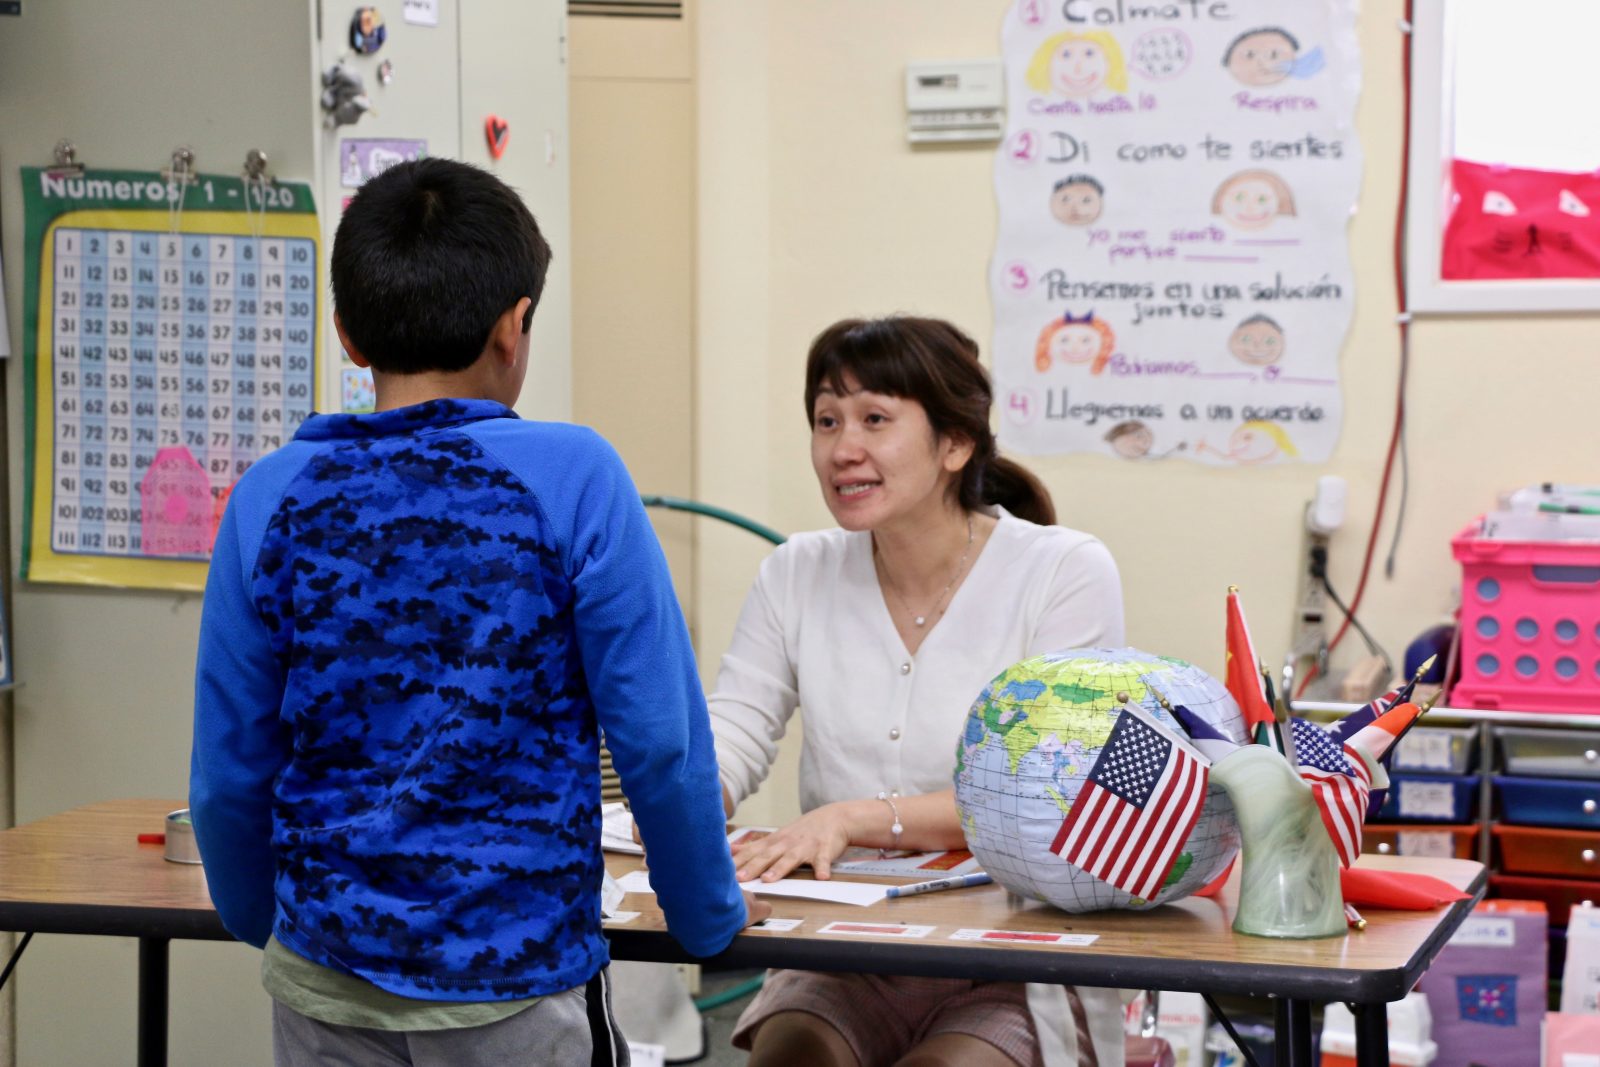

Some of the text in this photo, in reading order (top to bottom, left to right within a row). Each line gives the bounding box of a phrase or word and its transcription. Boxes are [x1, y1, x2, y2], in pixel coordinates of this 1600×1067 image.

[1026, 0, 1040, 24] 1
[1013, 131, 1344, 163] 2 Di como te sientes
[40, 173, 181, 201] Numeros
[204, 181, 215, 202] 1
[252, 187, 294, 207] 120
[66, 237, 308, 263] 1 2 3 4 5 6 7 8 9 10
[63, 265, 310, 291] 11 12 13 14 15 16 17 18 19 20
[1008, 265, 1030, 289] 3
[1040, 268, 1154, 301] Pensemos
[1164, 280, 1192, 299] en
[1202, 280, 1241, 300] una
[61, 291, 76, 307] 21
[85, 292, 104, 308] 22
[110, 293, 130, 309] 23
[136, 294, 156, 310] 24
[187, 297, 207, 313] 26
[213, 298, 232, 314] 27
[238, 299, 257, 315] 28
[263, 300, 283, 316] 29
[289, 301, 310, 318] 30
[1132, 301, 1224, 325] juntos
[60, 317, 76, 333] 31
[84, 318, 103, 335] 32
[110, 320, 129, 336] 33
[135, 321, 155, 337] 34
[186, 324, 206, 340] 36
[212, 325, 231, 340] 37
[237, 326, 257, 342] 38
[262, 327, 282, 343] 39
[287, 329, 309, 344] 40
[59, 346, 308, 371] 41 42 43 44 45 46 47 48 49 50
[60, 372, 308, 398] 51 52 53 54 55 56 57 58 59 60
[61, 399, 76, 413] 61
[84, 399, 104, 415] 62
[109, 400, 129, 416] 63
[135, 402, 155, 417] 64
[185, 405, 206, 420] 66
[211, 406, 230, 421] 67
[236, 407, 256, 423] 68
[261, 408, 282, 423] 69
[1009, 387, 1325, 426] 4 Lleguemos a un acuerdo
[61, 424, 76, 439] 71
[85, 425, 104, 441] 72
[111, 426, 129, 442] 73
[136, 427, 154, 443] 74
[161, 429, 179, 445] 75
[186, 430, 205, 447] 76
[212, 432, 230, 447] 77
[262, 434, 280, 449] 79
[61, 451, 76, 466] 81
[84, 451, 103, 467] 82
[109, 453, 128, 468] 83
[210, 458, 229, 474] 87
[60, 477, 76, 492] 91
[83, 478, 103, 495] 92
[109, 480, 128, 496] 93
[58, 506, 77, 519] 101
[81, 505, 105, 522] 102
[105, 507, 130, 523] 103
[58, 532, 75, 546] 111
[81, 533, 102, 548] 112
[107, 534, 127, 550] 113
